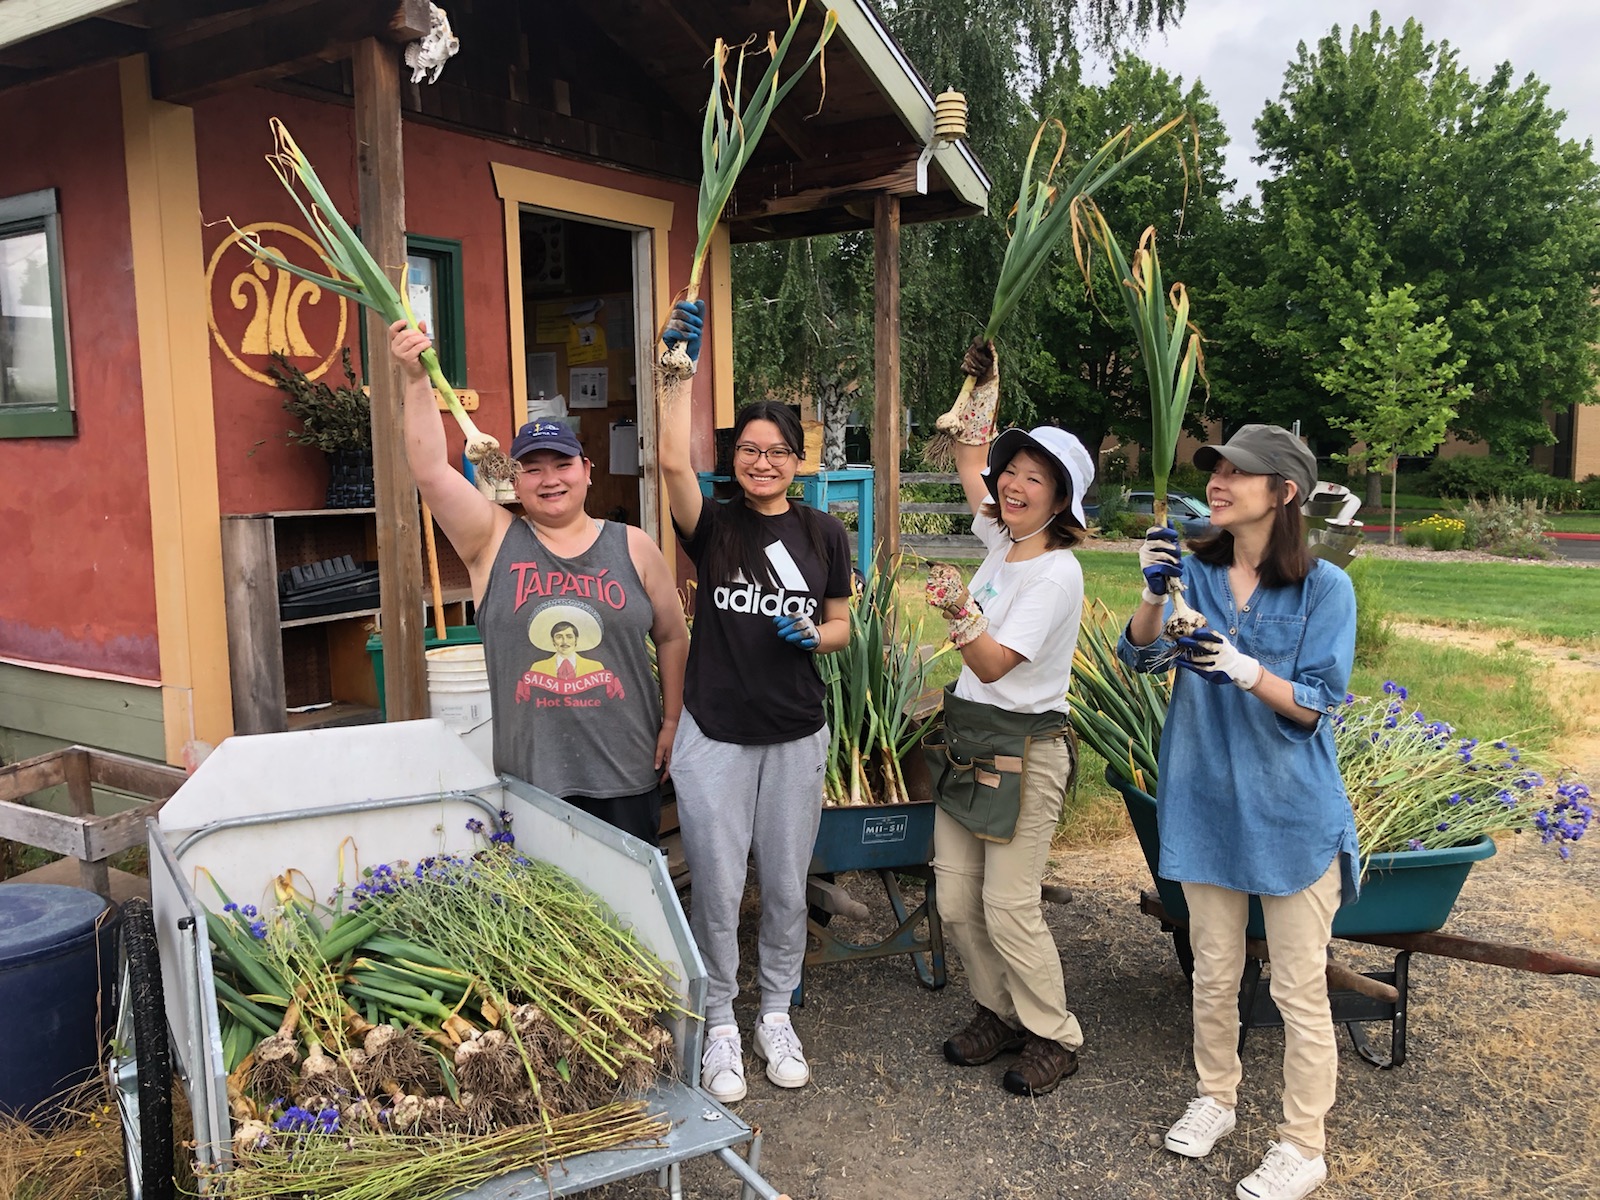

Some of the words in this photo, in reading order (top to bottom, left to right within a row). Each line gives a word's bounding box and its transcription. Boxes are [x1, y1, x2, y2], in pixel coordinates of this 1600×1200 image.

[510, 562, 626, 613] TAPATÍO
[714, 584, 818, 617] adidas
[524, 674, 559, 691] SALSA
[564, 673, 612, 692] PICANTE
[536, 697, 561, 708] Hot
[563, 696, 601, 707] Sauce
